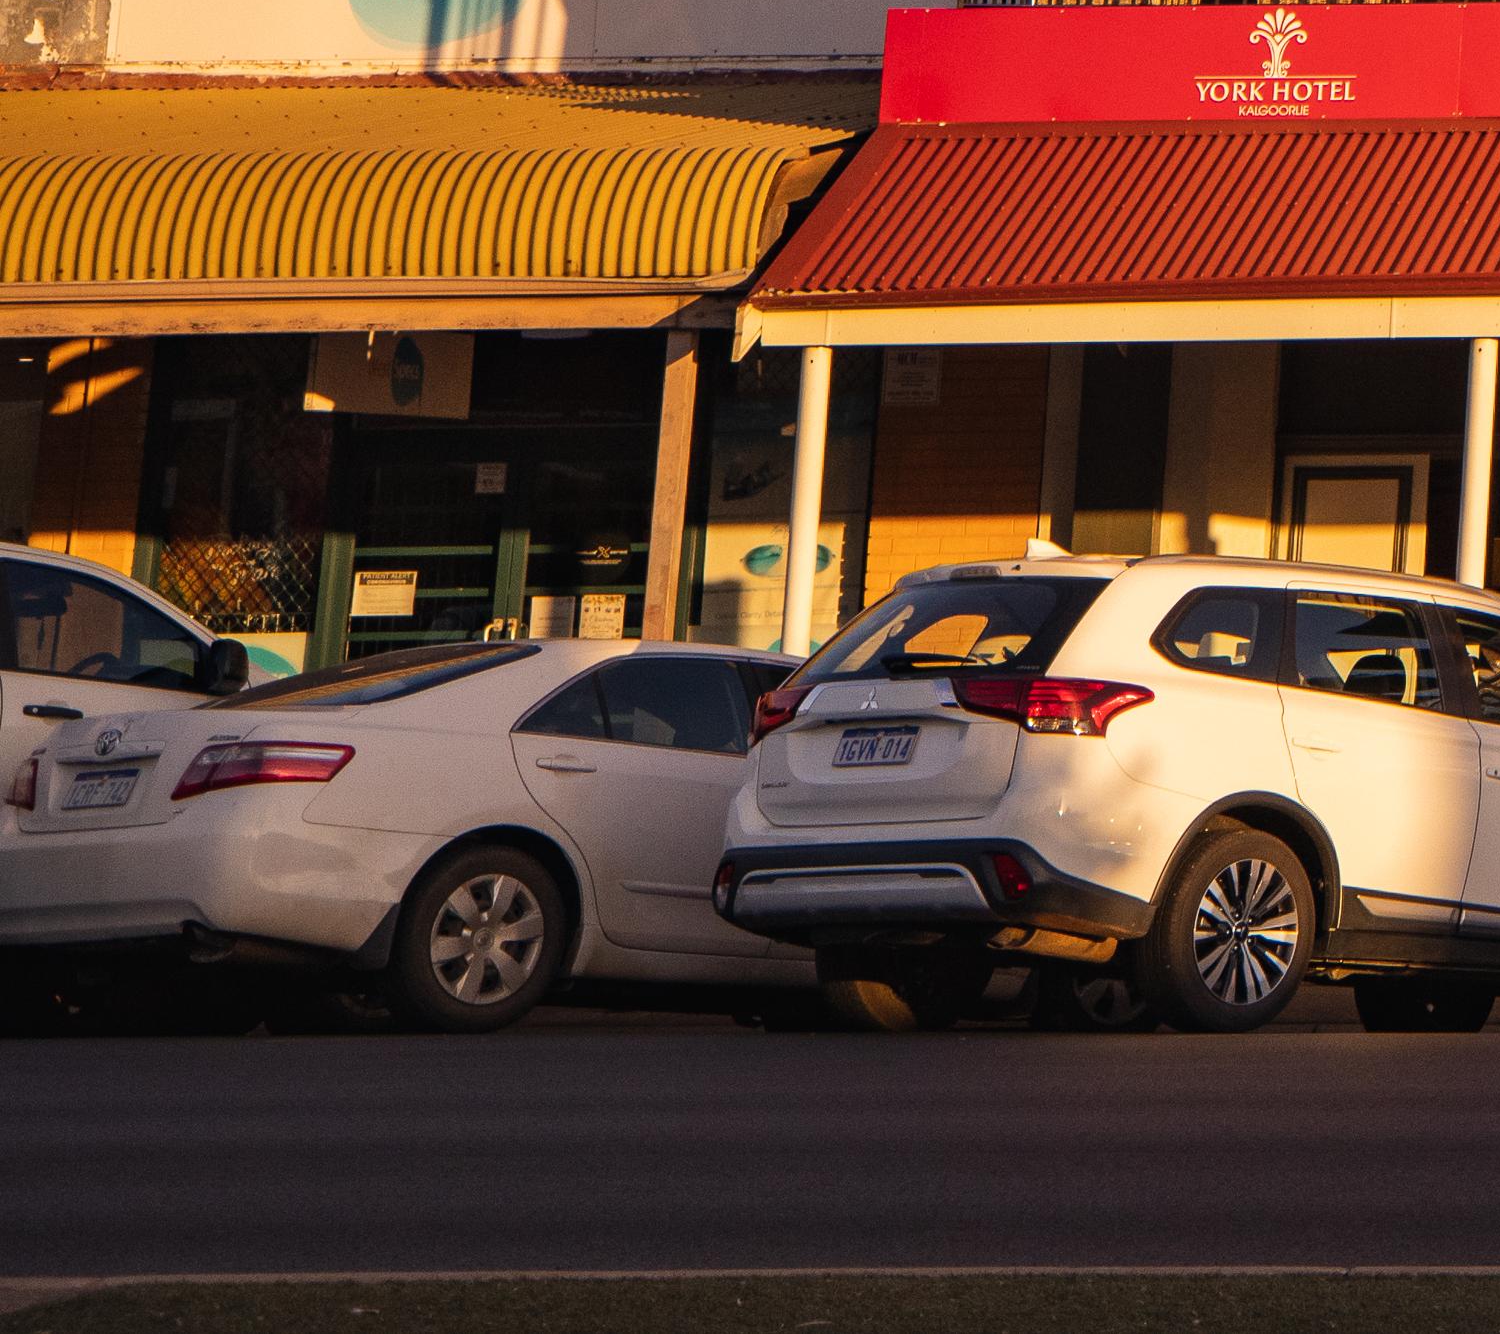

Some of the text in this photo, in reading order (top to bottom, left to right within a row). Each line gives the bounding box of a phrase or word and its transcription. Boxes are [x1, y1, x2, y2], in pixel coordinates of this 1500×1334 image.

[1195, 78, 1356, 103] YORK HOTEL
[1237, 104, 1309, 117] KALGOORLIE
[839, 737, 912, 762] 1GVN 014
